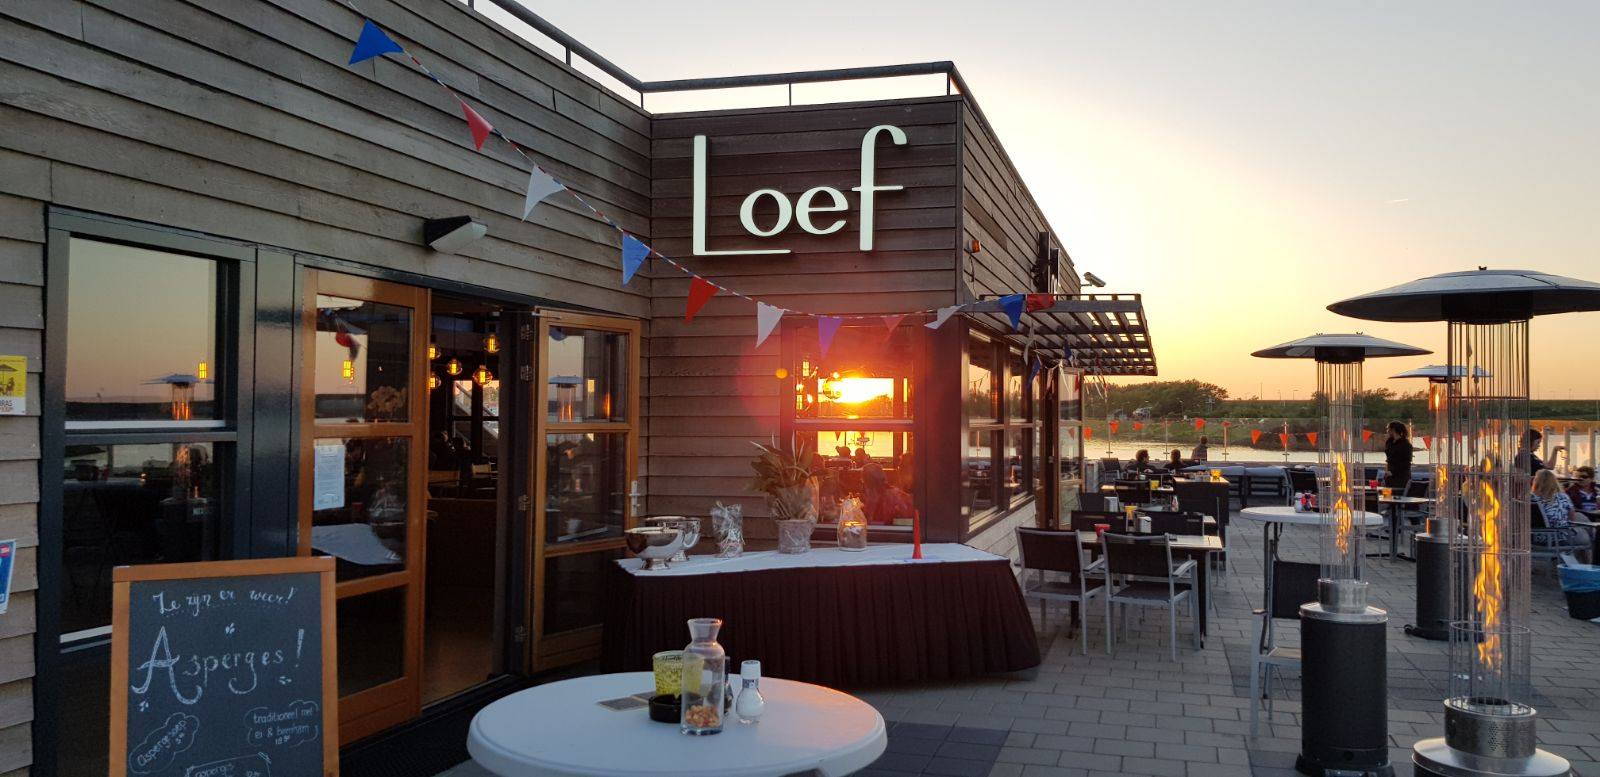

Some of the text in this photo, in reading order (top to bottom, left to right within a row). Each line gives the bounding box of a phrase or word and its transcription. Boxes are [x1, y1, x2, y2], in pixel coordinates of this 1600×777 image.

[692, 124, 908, 257] Loef
[152, 591, 181, 614] Ze
[219, 590, 235, 600] er
